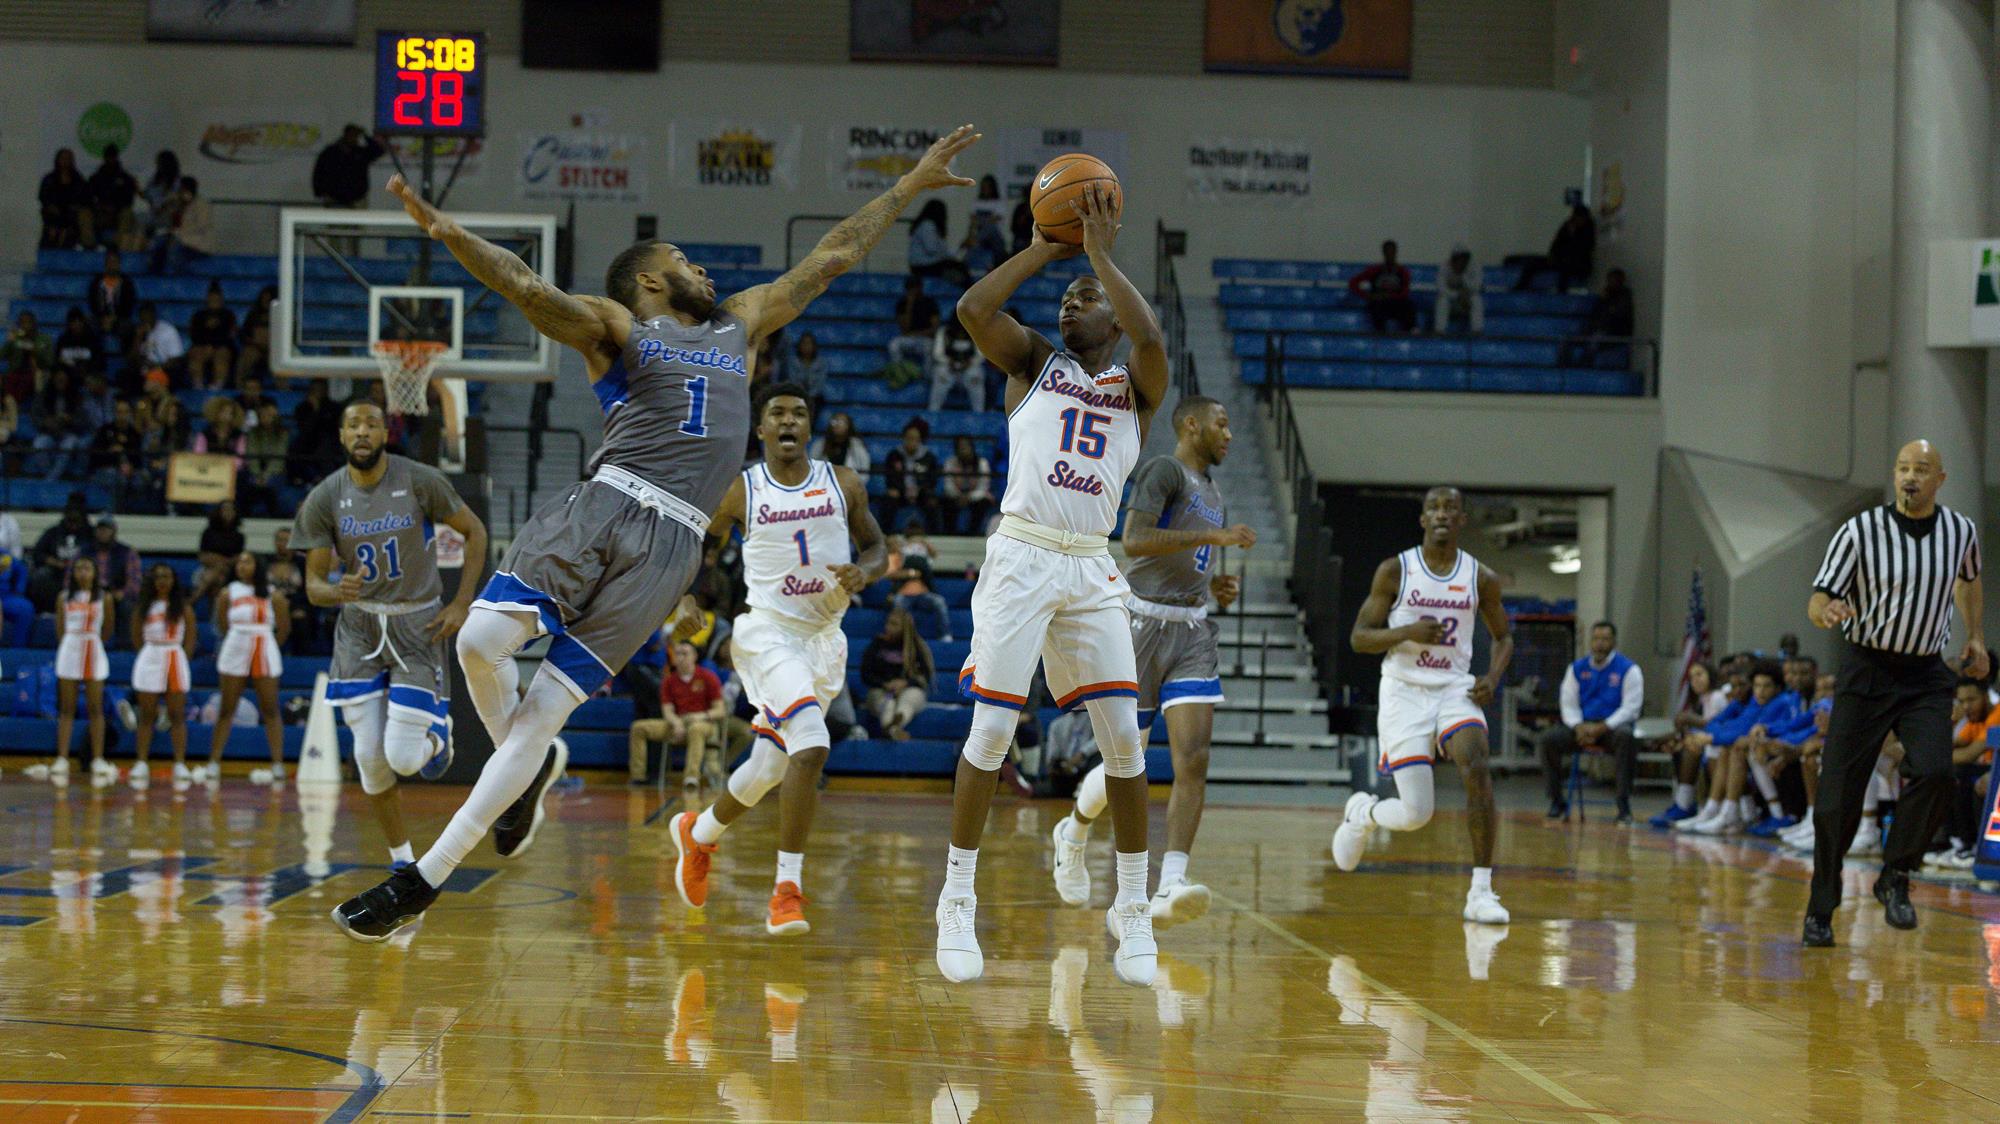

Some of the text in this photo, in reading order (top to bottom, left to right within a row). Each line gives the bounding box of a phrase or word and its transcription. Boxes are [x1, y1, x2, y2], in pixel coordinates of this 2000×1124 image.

[397, 37, 475, 72] 15:08
[394, 71, 464, 126] 28
[559, 165, 629, 190] STITCH
[637, 337, 747, 377] Pirates
[678, 374, 709, 438] 1
[1041, 368, 1132, 411] Savannah
[1059, 406, 1113, 460] 15
[1046, 459, 1104, 497] State
[339, 510, 415, 538] Pirates
[757, 497, 836, 525] Savannah
[1185, 491, 1224, 529] Pirat
[355, 535, 404, 584] 31
[792, 528, 811, 568] 1
[1193, 543, 1212, 575] 4
[781, 574, 826, 597] State
[1407, 588, 1473, 611] Savannah
[1418, 613, 1459, 648] 2
[1416, 650, 1453, 671] State
